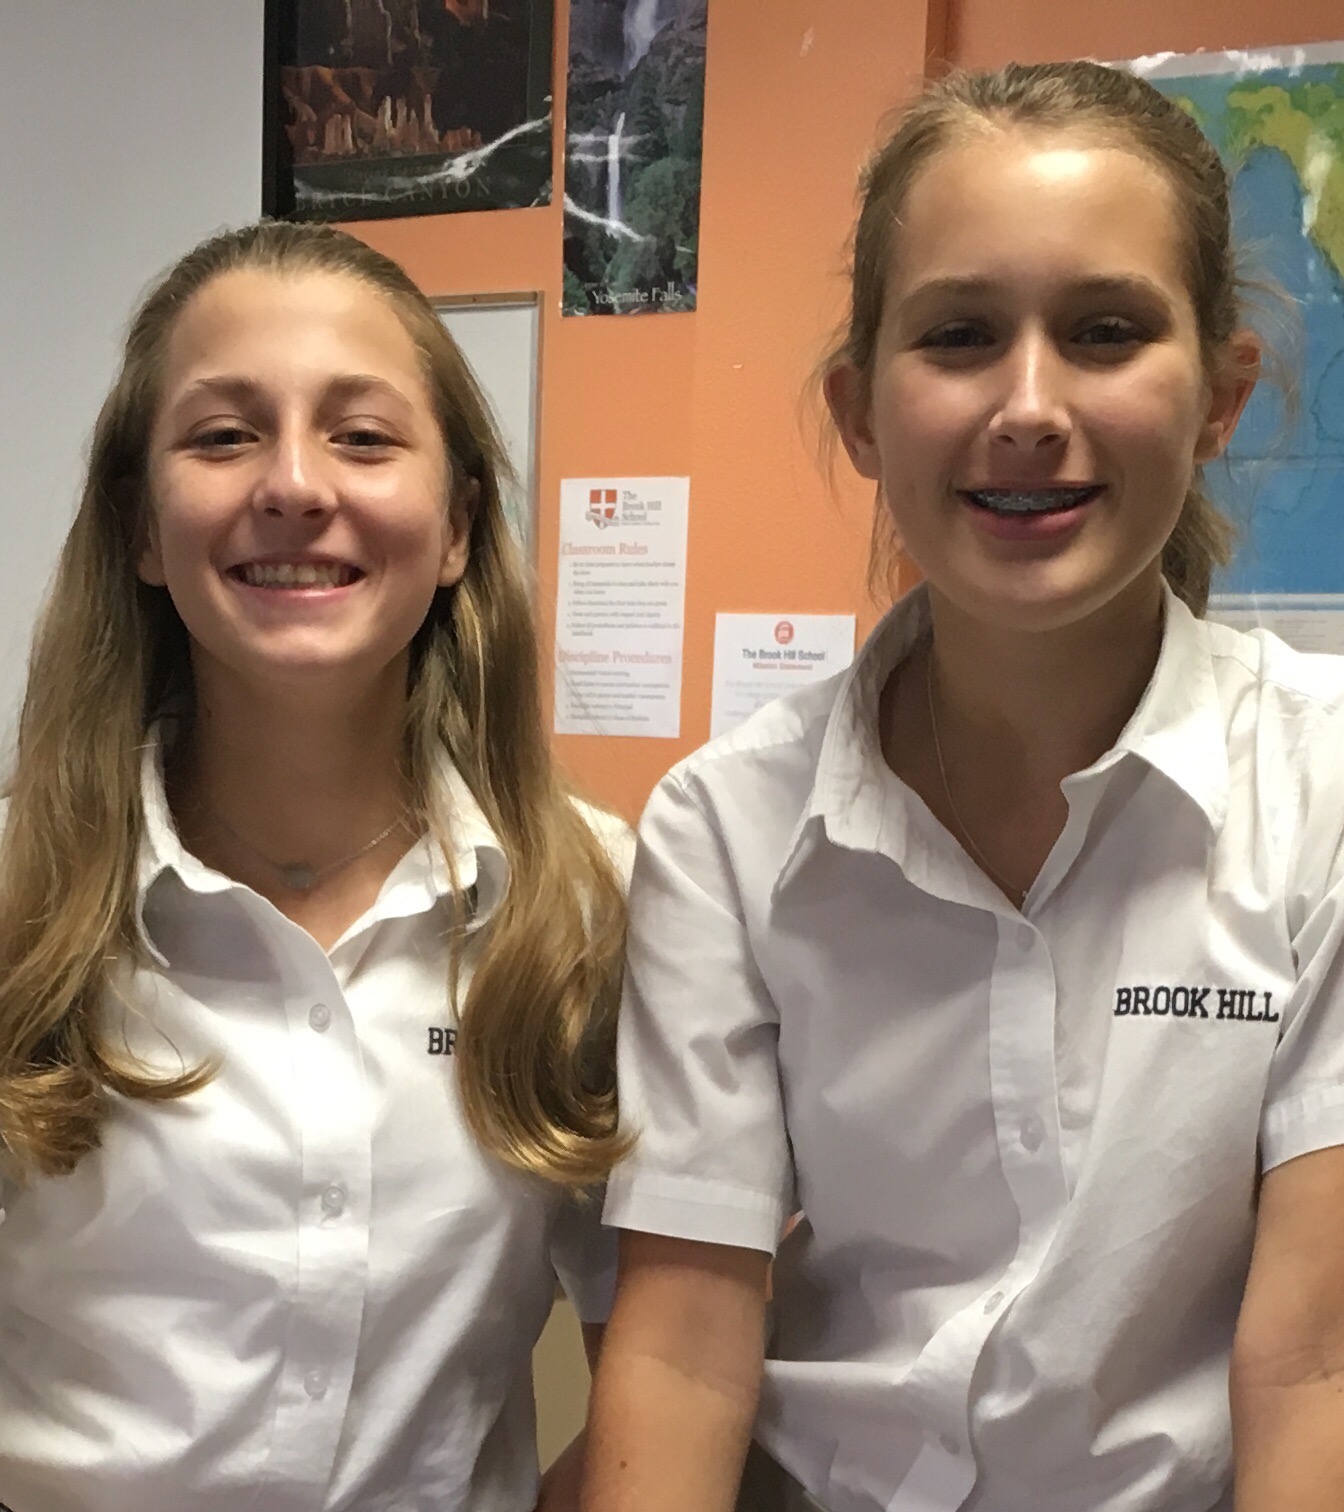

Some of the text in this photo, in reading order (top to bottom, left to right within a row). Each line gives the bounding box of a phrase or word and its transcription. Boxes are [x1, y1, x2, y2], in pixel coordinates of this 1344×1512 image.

[652, 281, 682, 303] Falls
[622, 491, 637, 500] The
[622, 512, 647, 521] School
[562, 542, 648, 556] Classroom Rules
[612, 650, 672, 664] Procedures
[742, 649, 825, 661] The Brook Hill School
[1114, 985, 1279, 1022] BROOK HILL
